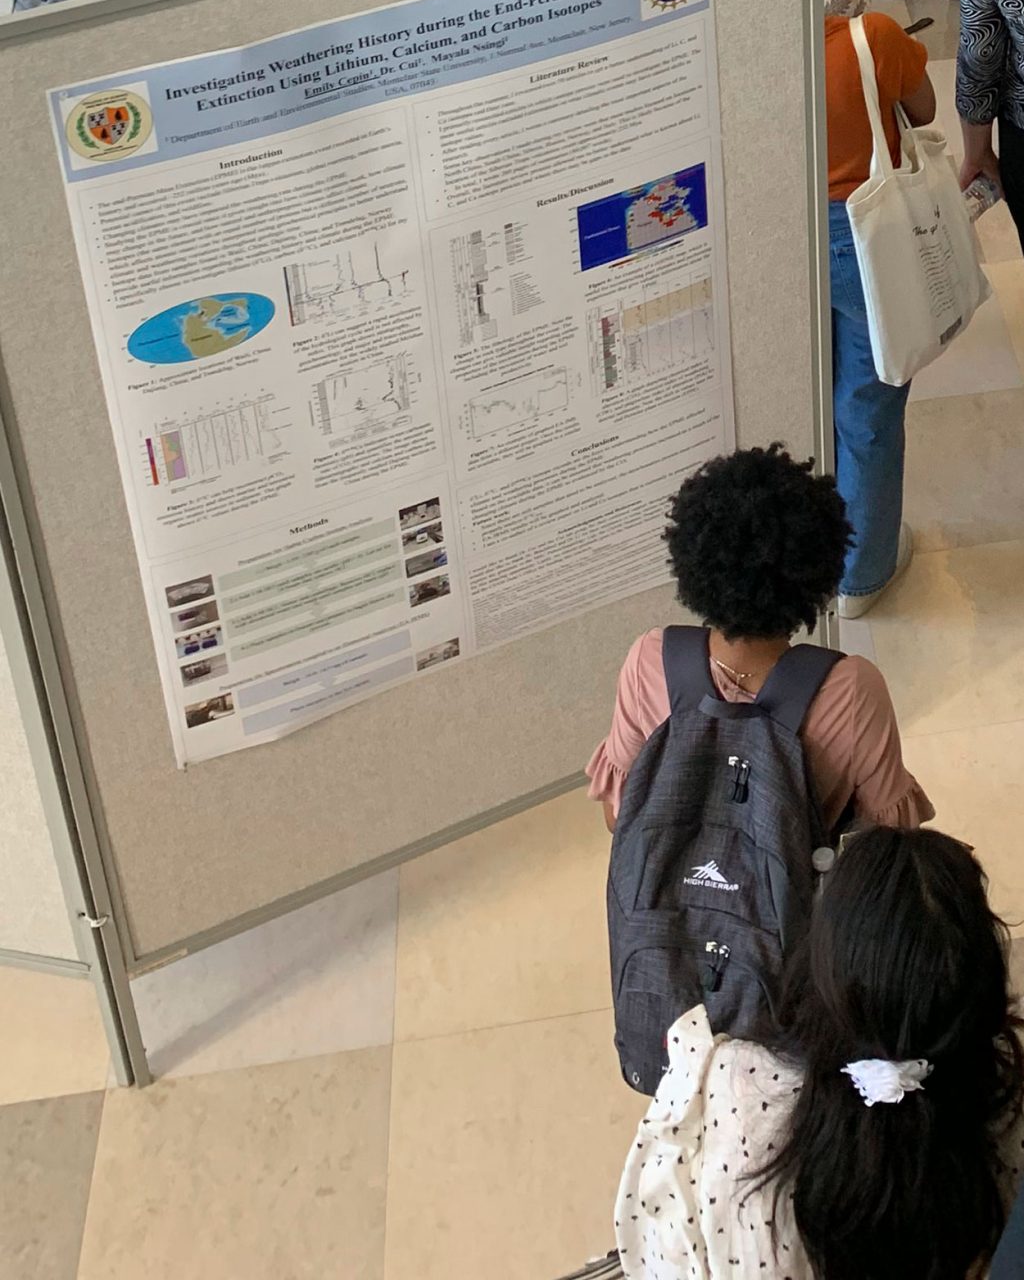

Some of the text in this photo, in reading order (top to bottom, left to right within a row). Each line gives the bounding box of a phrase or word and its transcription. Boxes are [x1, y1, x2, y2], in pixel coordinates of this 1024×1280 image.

[166, 67, 264, 101] Investigating
[269, 41, 352, 74] Weathering
[358, 26, 411, 49] History
[417, 14, 465, 34] during
[468, 6, 490, 22] the
[196, 84, 274, 111] Extinction
[280, 71, 322, 90] Using
[460, 23, 486, 42] and
[490, 12, 544, 34] Carbon
[304, 81, 335, 96] Emily
[379, 66, 396, 77] Dr.
[432, 46, 470, 63] Mayala
[529, 56, 608, 84] Literature Review
[219, 148, 283, 170] Introduction
[536, 177, 614, 208] Results/Discussion
[571, 434, 619, 456] Conclusions
[289, 517, 328, 536] Methods
[683, 877, 704, 886] HIGH
